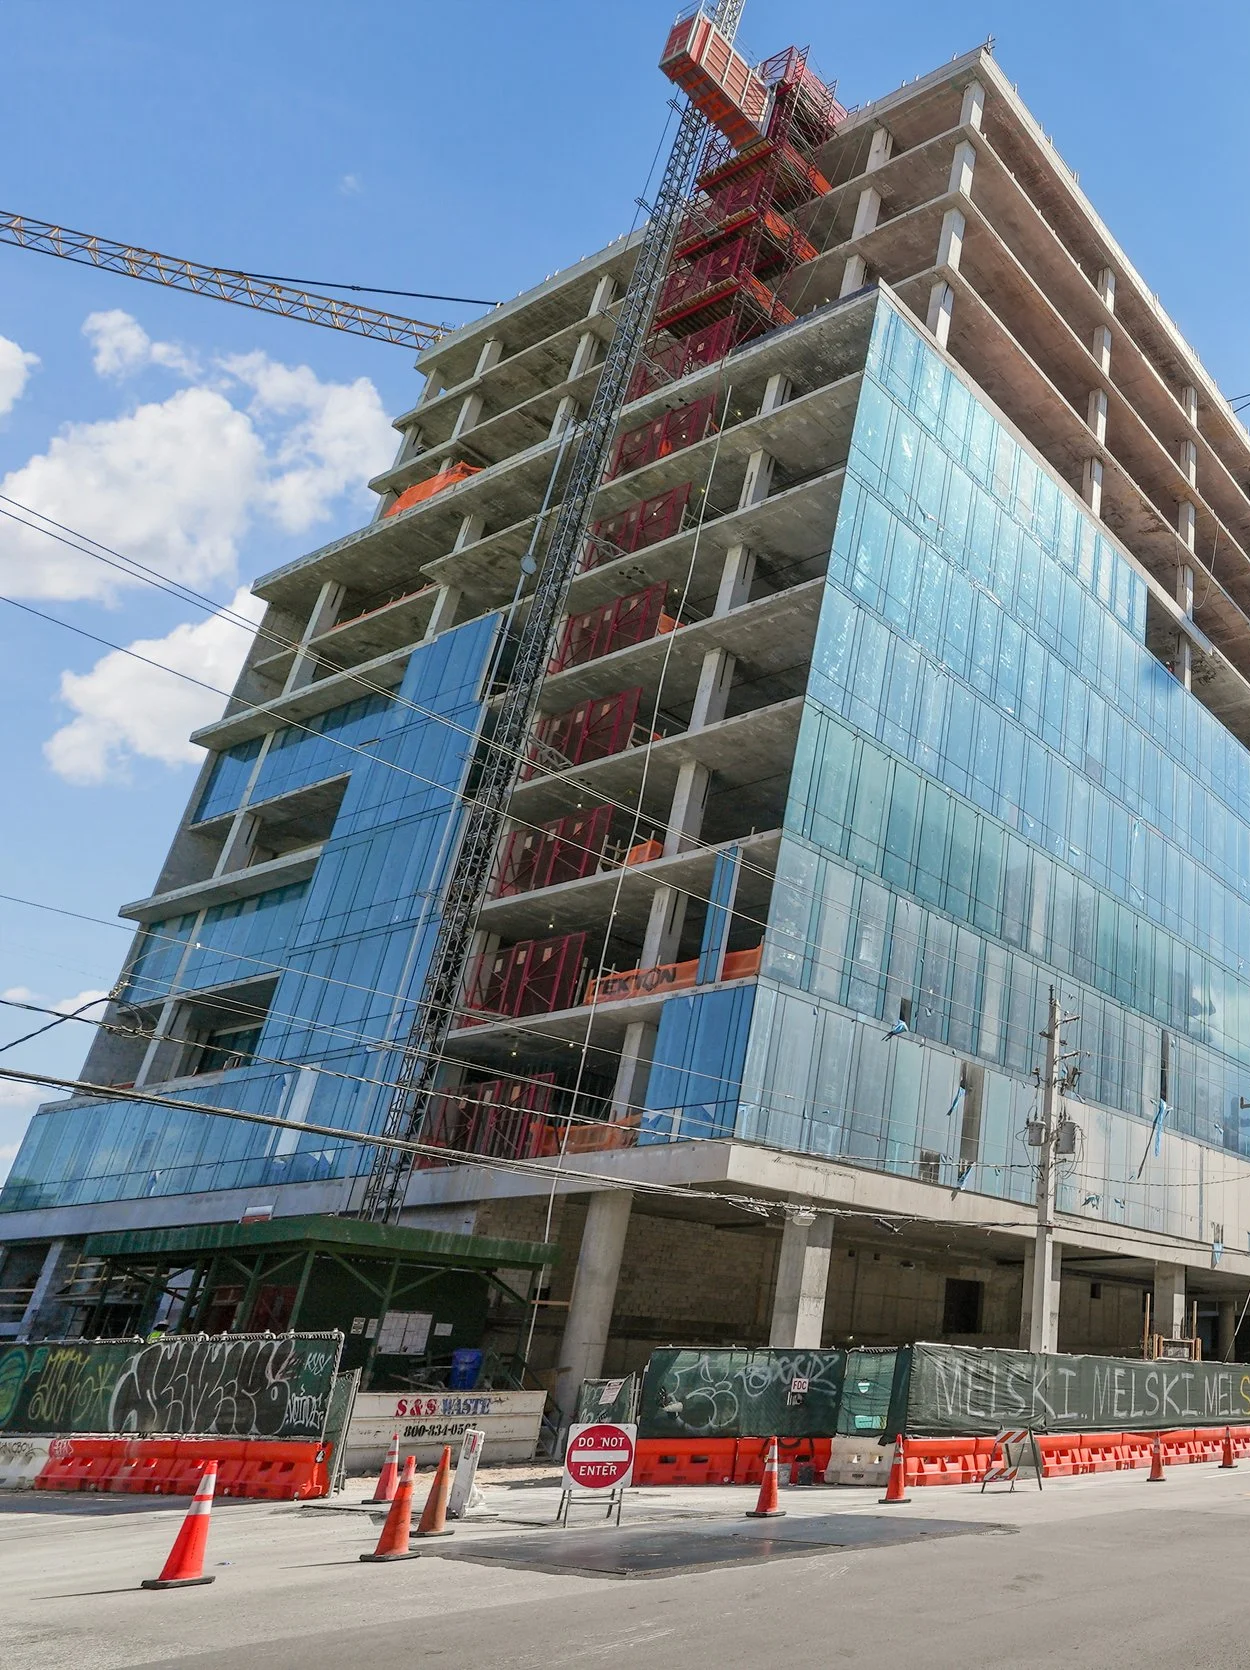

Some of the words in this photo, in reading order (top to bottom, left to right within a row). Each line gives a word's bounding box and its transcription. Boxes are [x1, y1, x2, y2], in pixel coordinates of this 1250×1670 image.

[793, 1380, 807, 1390] FDC
[442, 1398, 490, 1416] WASTE
[578, 1437, 594, 1448] DO
[602, 1437, 624, 1447] NOT
[579, 1465, 617, 1476] ENTER
